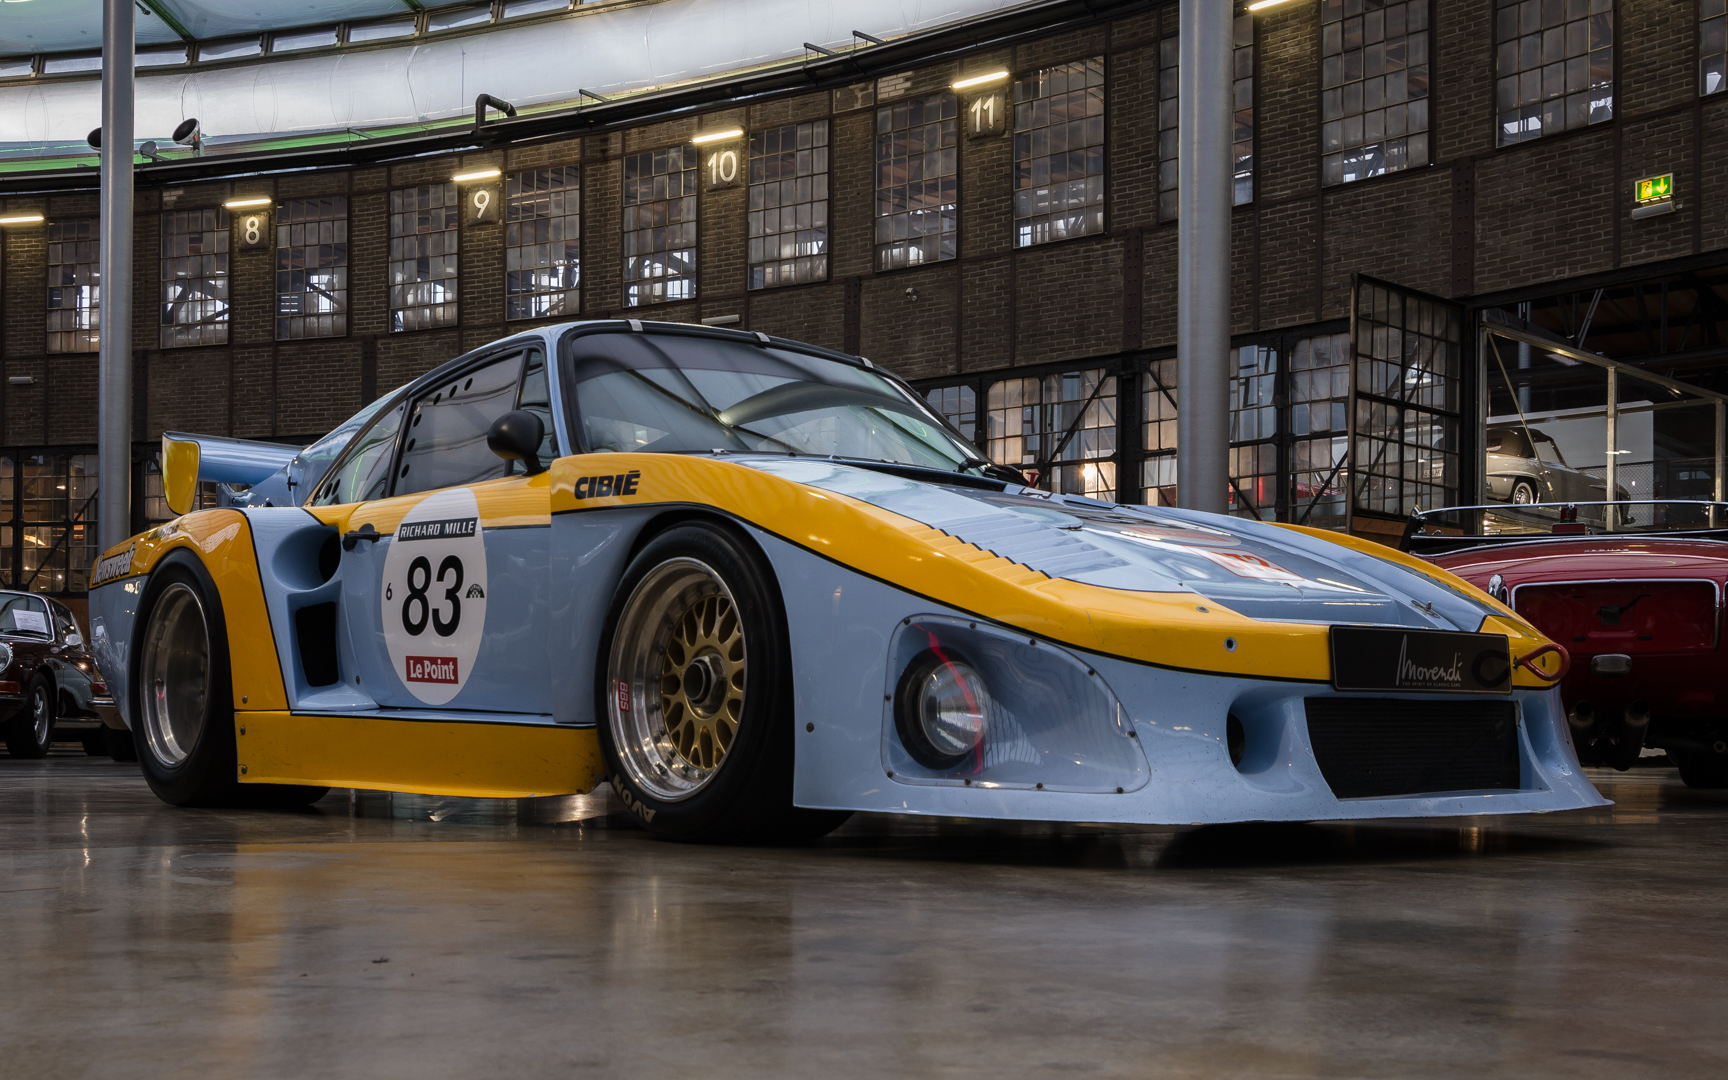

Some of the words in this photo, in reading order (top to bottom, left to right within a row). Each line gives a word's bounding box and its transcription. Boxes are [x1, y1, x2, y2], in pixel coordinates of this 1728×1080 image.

[970, 94, 995, 133] 11
[707, 150, 737, 185] 10
[473, 190, 490, 219] 9
[245, 216, 260, 245] 8
[400, 523, 441, 538] RICHARD
[444, 521, 475, 535] MILLE
[385, 582, 393, 601] 6
[401, 554, 465, 637] 83
[409, 660, 423, 678] Le
[423, 659, 455, 680] Point
[1395, 633, 1463, 686] Movendi
[619, 682, 629, 711] BBS
[613, 774, 657, 824] AVON
